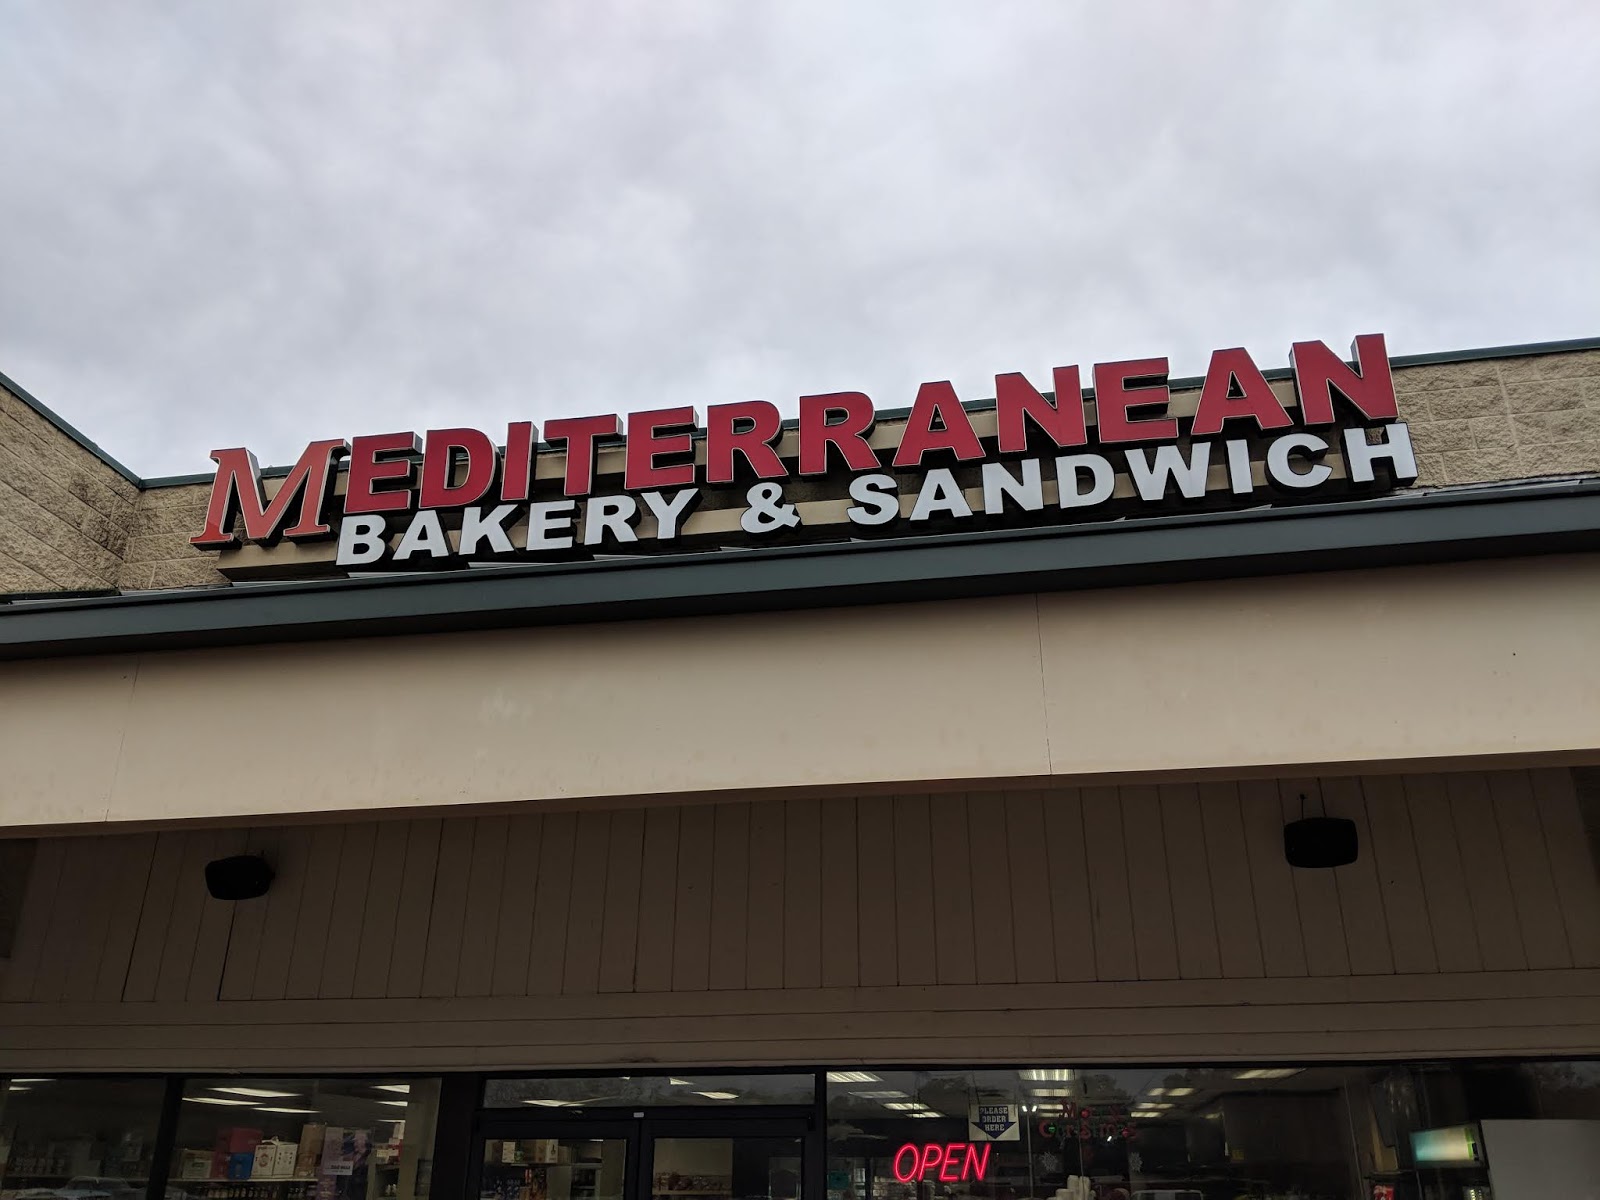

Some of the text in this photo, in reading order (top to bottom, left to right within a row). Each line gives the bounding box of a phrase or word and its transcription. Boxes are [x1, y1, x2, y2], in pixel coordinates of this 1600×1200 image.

[189, 333, 1398, 545] MEDITERRANEAN
[336, 422, 1418, 566] BAKERY & SANDWICH
[980, 1107, 1008, 1115] PLEASE
[981, 1115, 1007, 1123] ORDER
[893, 1143, 992, 1183] OPEN
